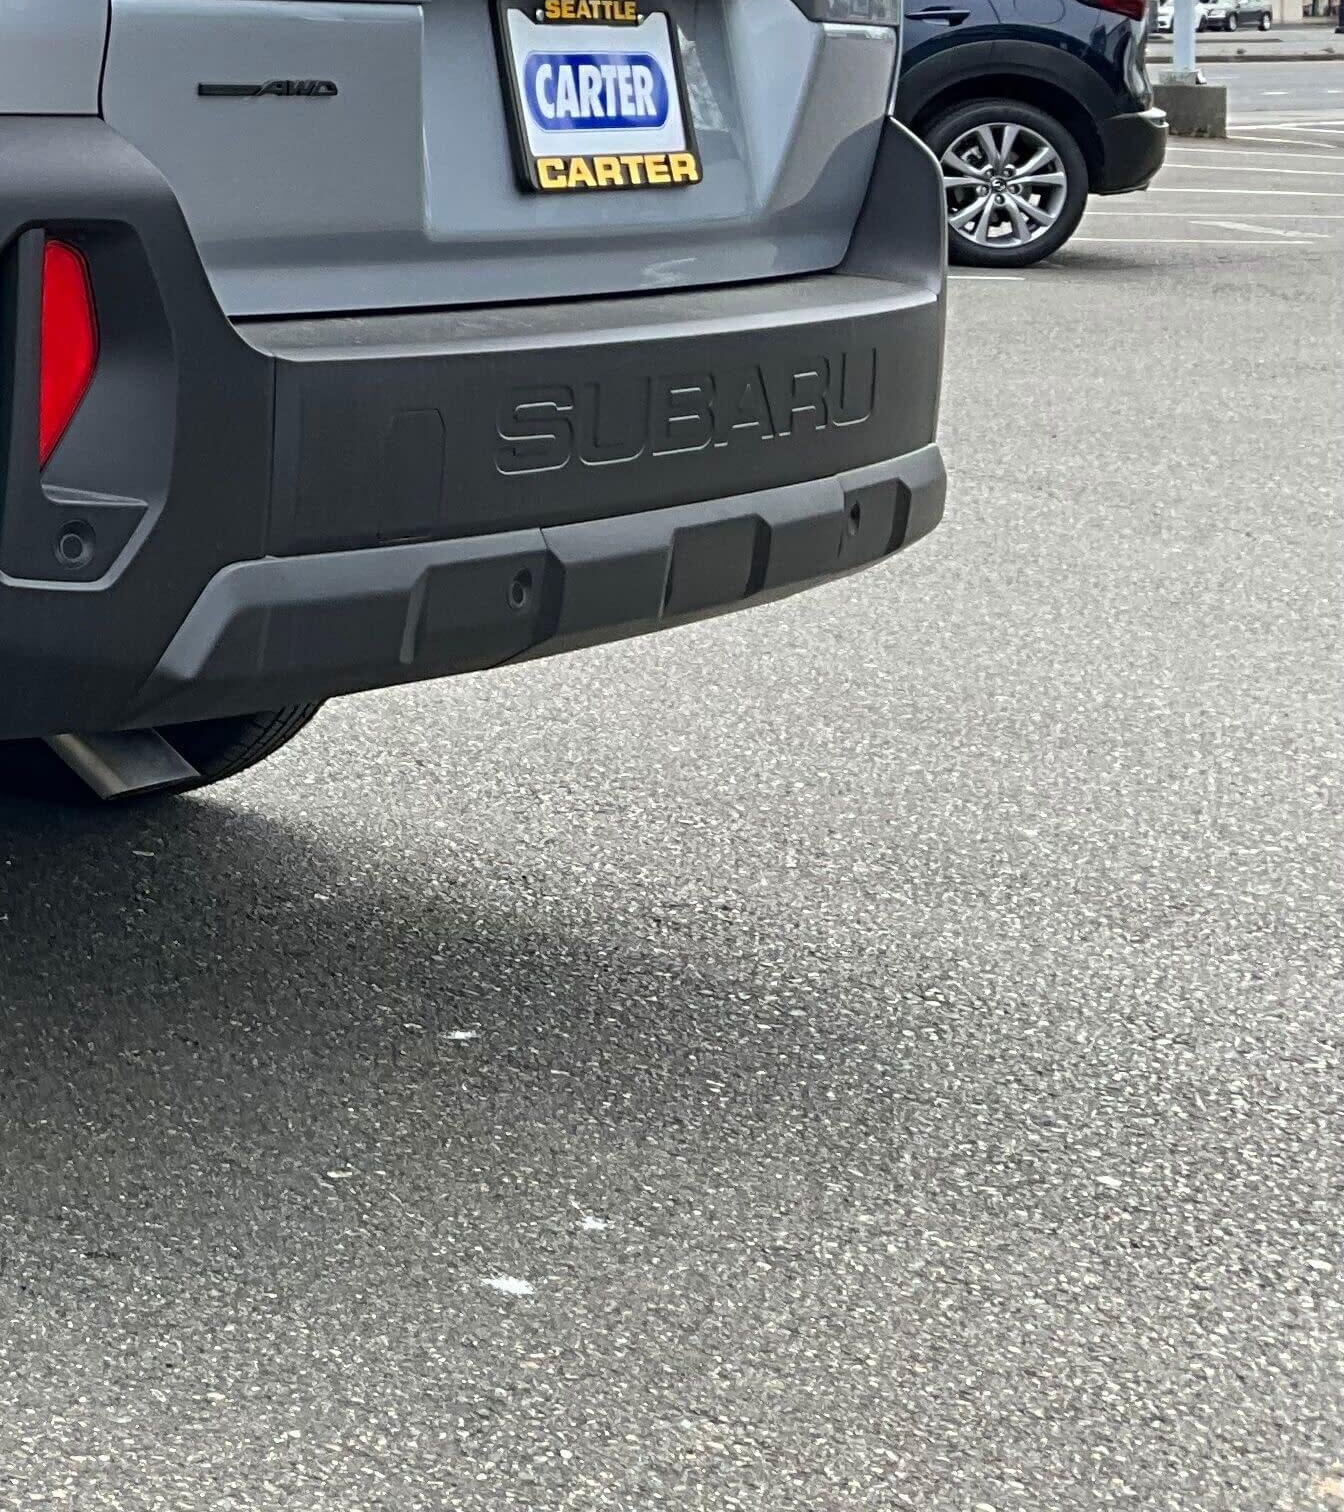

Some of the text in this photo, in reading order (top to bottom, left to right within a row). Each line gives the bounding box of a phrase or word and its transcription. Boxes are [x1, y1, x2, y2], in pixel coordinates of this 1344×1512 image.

[260, 80, 338, 96] AWD
[535, 63, 657, 120] CARTER
[536, 152, 700, 189] CARTER
[494, 347, 879, 477] SUBARU
